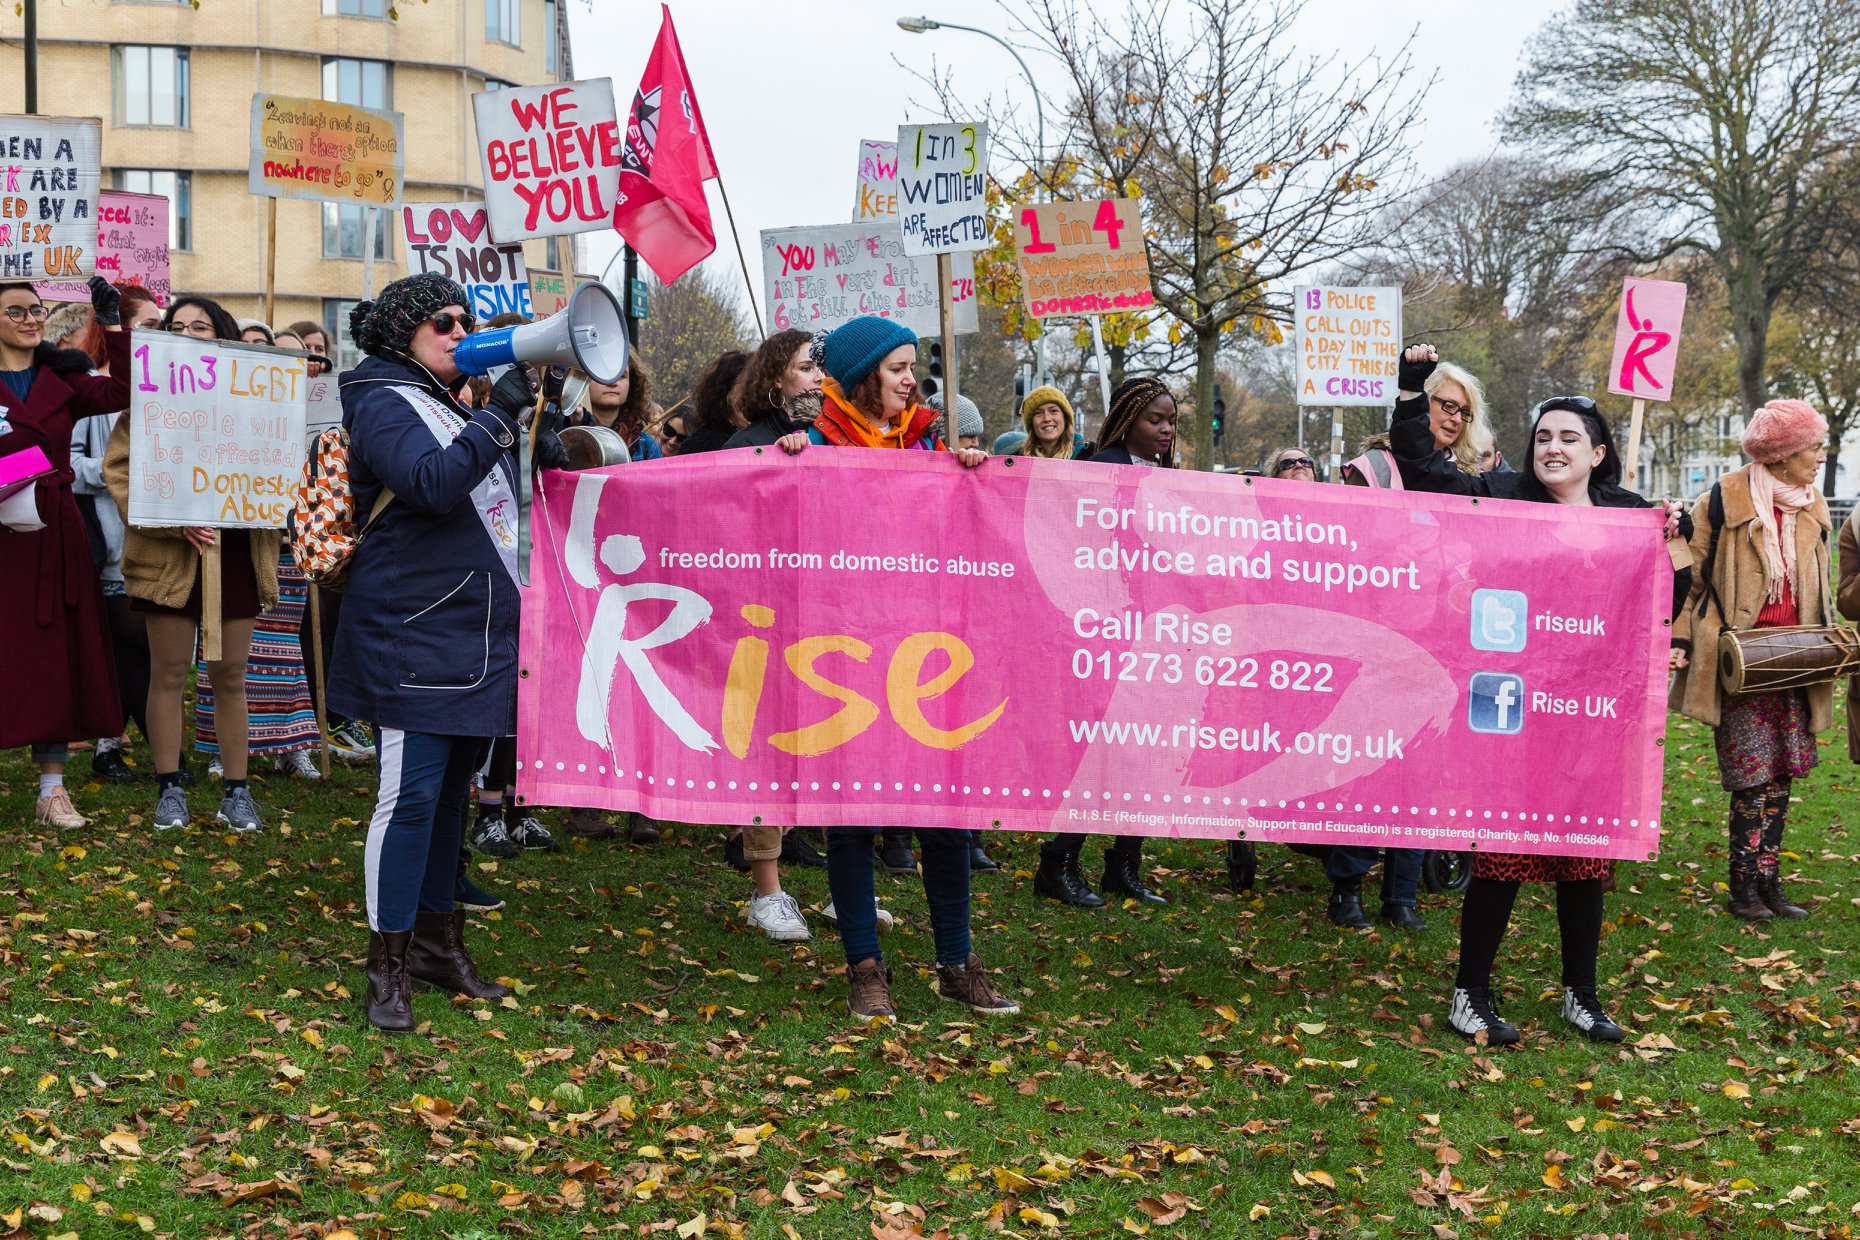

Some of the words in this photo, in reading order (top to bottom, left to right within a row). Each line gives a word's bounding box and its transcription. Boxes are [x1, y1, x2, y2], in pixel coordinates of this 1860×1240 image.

[329, 115, 352, 132] not
[511, 87, 578, 132] WE
[266, 131, 303, 152] when
[355, 120, 370, 134] an
[54, 139, 74, 162] A
[355, 133, 397, 157] option
[487, 121, 622, 182] BELIEVE
[961, 126, 978, 175] 3
[30, 167, 78, 191] ARE
[263, 159, 332, 184] nowhere
[334, 164, 351, 188] to
[39, 196, 65, 223] BY
[73, 199, 88, 218] A
[513, 175, 610, 232] YOU
[903, 213, 926, 237] ARE
[922, 215, 987, 248] AFFECTED
[1021, 209, 1056, 253] 1
[1057, 212, 1092, 245] in
[1092, 200, 1125, 250] 4
[44, 245, 83, 276] UK
[866, 236, 905, 258] tro
[1106, 251, 1148, 272] will
[457, 245, 522, 283] NOT
[774, 280, 794, 299] in
[883, 260, 919, 287] dirt
[1029, 278, 1055, 299] be
[1127, 270, 1150, 293] by
[1306, 289, 1321, 310] 13
[1327, 290, 1376, 311] POLICE
[1305, 315, 1345, 334] CALL
[1350, 318, 1391, 337] OUTS
[1305, 336, 1314, 352] A
[1318, 337, 1346, 353] DAY
[1351, 339, 1366, 355] IN
[1371, 341, 1397, 357] THE
[134, 344, 159, 392] 1
[199, 355, 217, 391] 3
[1348, 357, 1382, 375] THIS
[1384, 361, 1397, 376] IS
[1304, 378, 1315, 395] A
[1326, 376, 1384, 398] CRISIS
[250, 416, 288, 441] will
[154, 434, 184, 463] be
[197, 441, 298, 468] affected
[142, 462, 174, 499] by
[192, 466, 300, 500] Domestic
[220, 494, 294, 525] Abus
[1075, 498, 1136, 531] For
[1146, 503, 1358, 551] information,
[659, 547, 761, 570] freedom
[767, 548, 822, 570] from
[829, 550, 939, 574] domestic
[946, 556, 1015, 577] abuse
[1073, 541, 1195, 575] advice
[1205, 551, 1272, 580] and
[1282, 560, 1421, 593] support
[1072, 608, 1143, 641] Call
[1155, 612, 1232, 645] Rise
[1535, 610, 1606, 636] riseuk
[576, 580, 1009, 760] Rise
[1071, 649, 1183, 684] 01273
[1194, 654, 1259, 688] 622
[1269, 660, 1333, 693] 822
[1532, 691, 1579, 716] Rise
[1585, 695, 1617, 719] UK
[1068, 718, 1404, 765] www.riseuk.org.uk
[1069, 809, 1112, 821] R.I.S.E
[1115, 810, 1168, 827] (Refuge,
[1171, 812, 1245, 828] Information,
[1247, 817, 1297, 832] Support
[1299, 819, 1322, 832] and
[1325, 820, 1389, 837] Education)
[1391, 824, 1402, 835] is
[1404, 826, 1412, 835] a
[1415, 826, 1475, 841] registered
[1478, 828, 1521, 842] Charity.
[1524, 831, 1541, 843] Reg.
[1544, 831, 1562, 843] No.
[1565, 833, 1609, 846] 1065846
